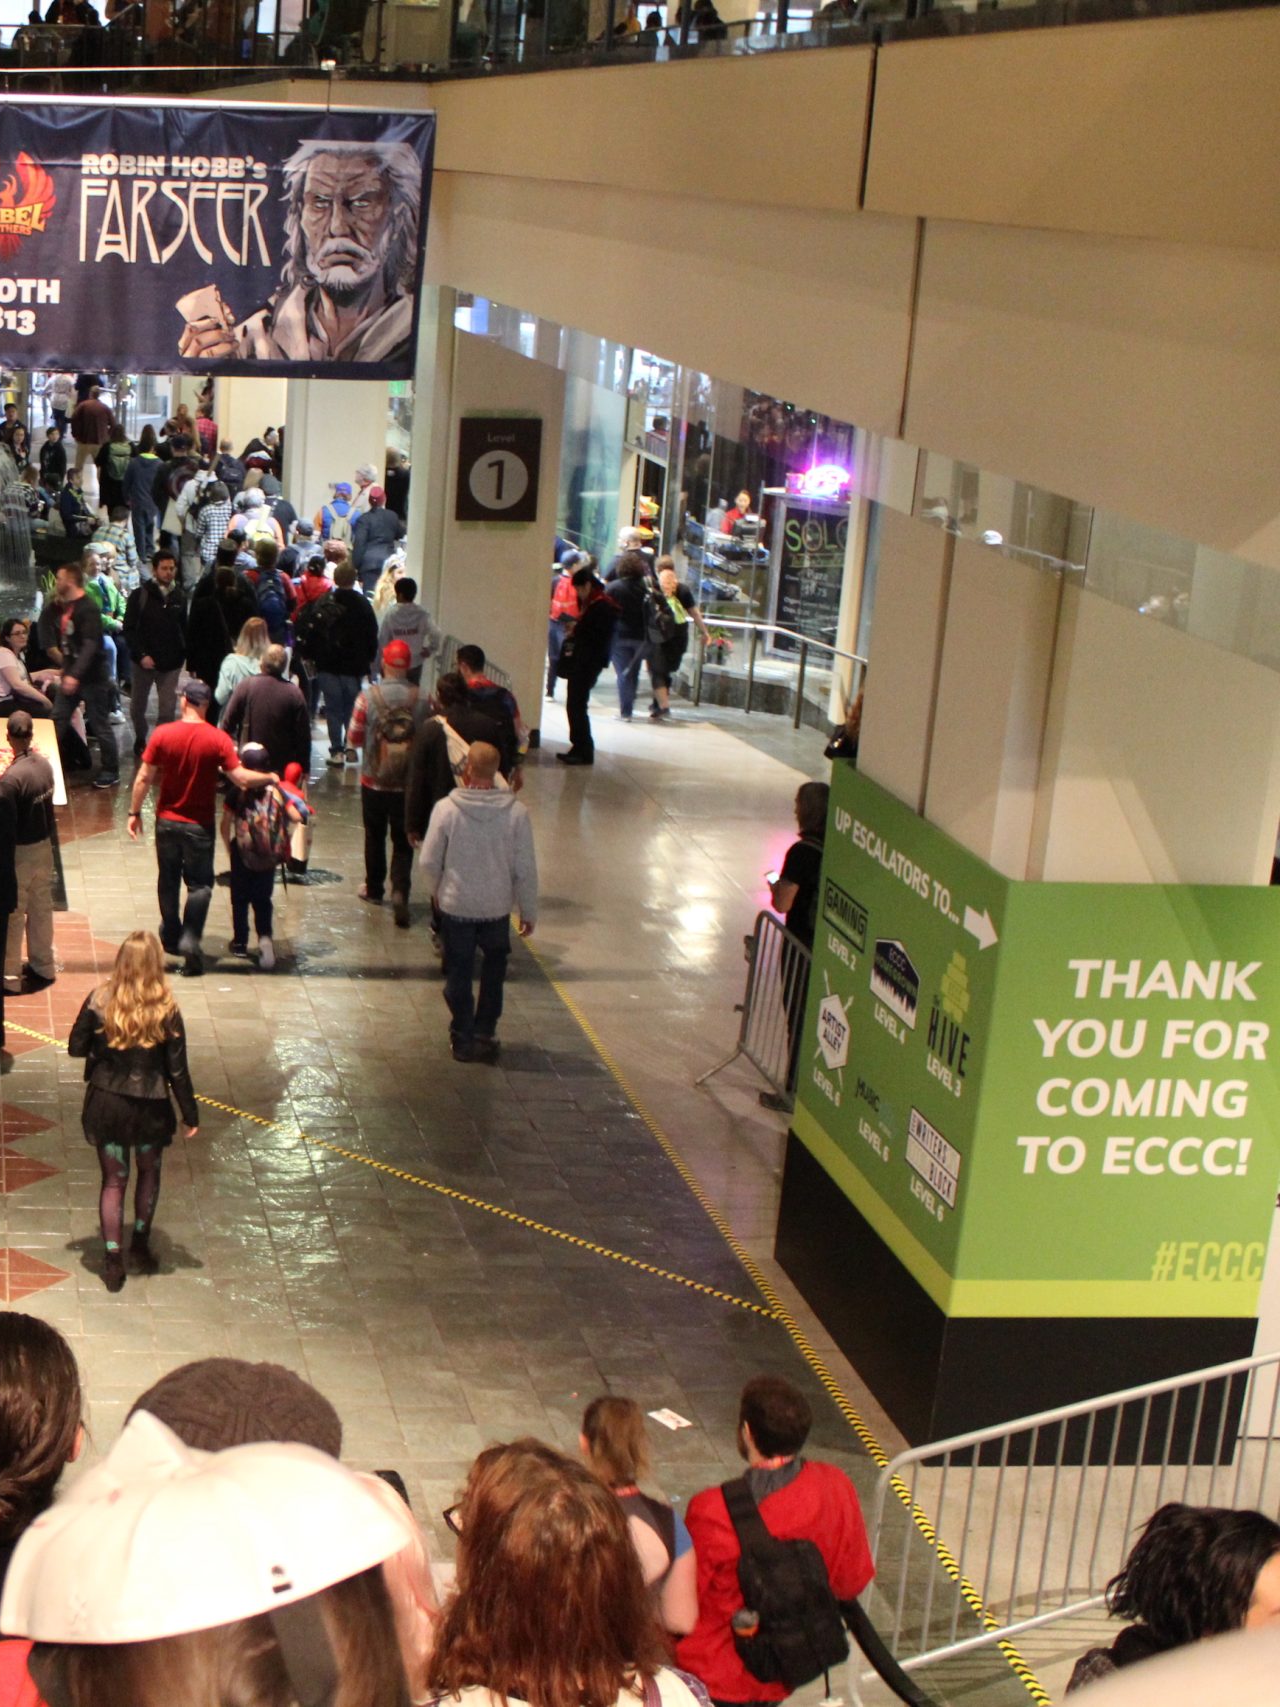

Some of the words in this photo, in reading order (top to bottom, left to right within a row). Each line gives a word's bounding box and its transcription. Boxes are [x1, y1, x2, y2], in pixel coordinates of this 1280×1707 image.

[82, 154, 165, 176] ROBIN
[79, 179, 271, 267] FARSEER
[487, 433, 515, 443] Level
[487, 460, 504, 500] 1
[835, 806, 851, 835] UP
[852, 820, 930, 899] ESCALATORS
[826, 887, 867, 935] GAMING
[827, 934, 850, 965] LEVEL
[849, 955, 858, 971] 2
[1067, 959, 1263, 1001] THANK
[822, 1008, 846, 1041] ARTIST
[875, 1002, 898, 1039] LEVEL
[1033, 1018, 1148, 1059] YOU
[1161, 1020, 1271, 1061] FOR
[928, 1006, 970, 1078] HIVE
[813, 1067, 834, 1101] LEVEL
[927, 1053, 953, 1092] LEVEL
[953, 1078, 962, 1099] 3
[1035, 1078, 1248, 1118] COMING
[859, 1118, 882, 1155] LEVEL
[1017, 1136, 1086, 1175] TO
[1101, 1136, 1253, 1176] ECCC!
[910, 1175, 936, 1215] LEVEL
[928, 1159, 952, 1199] BLOCK
